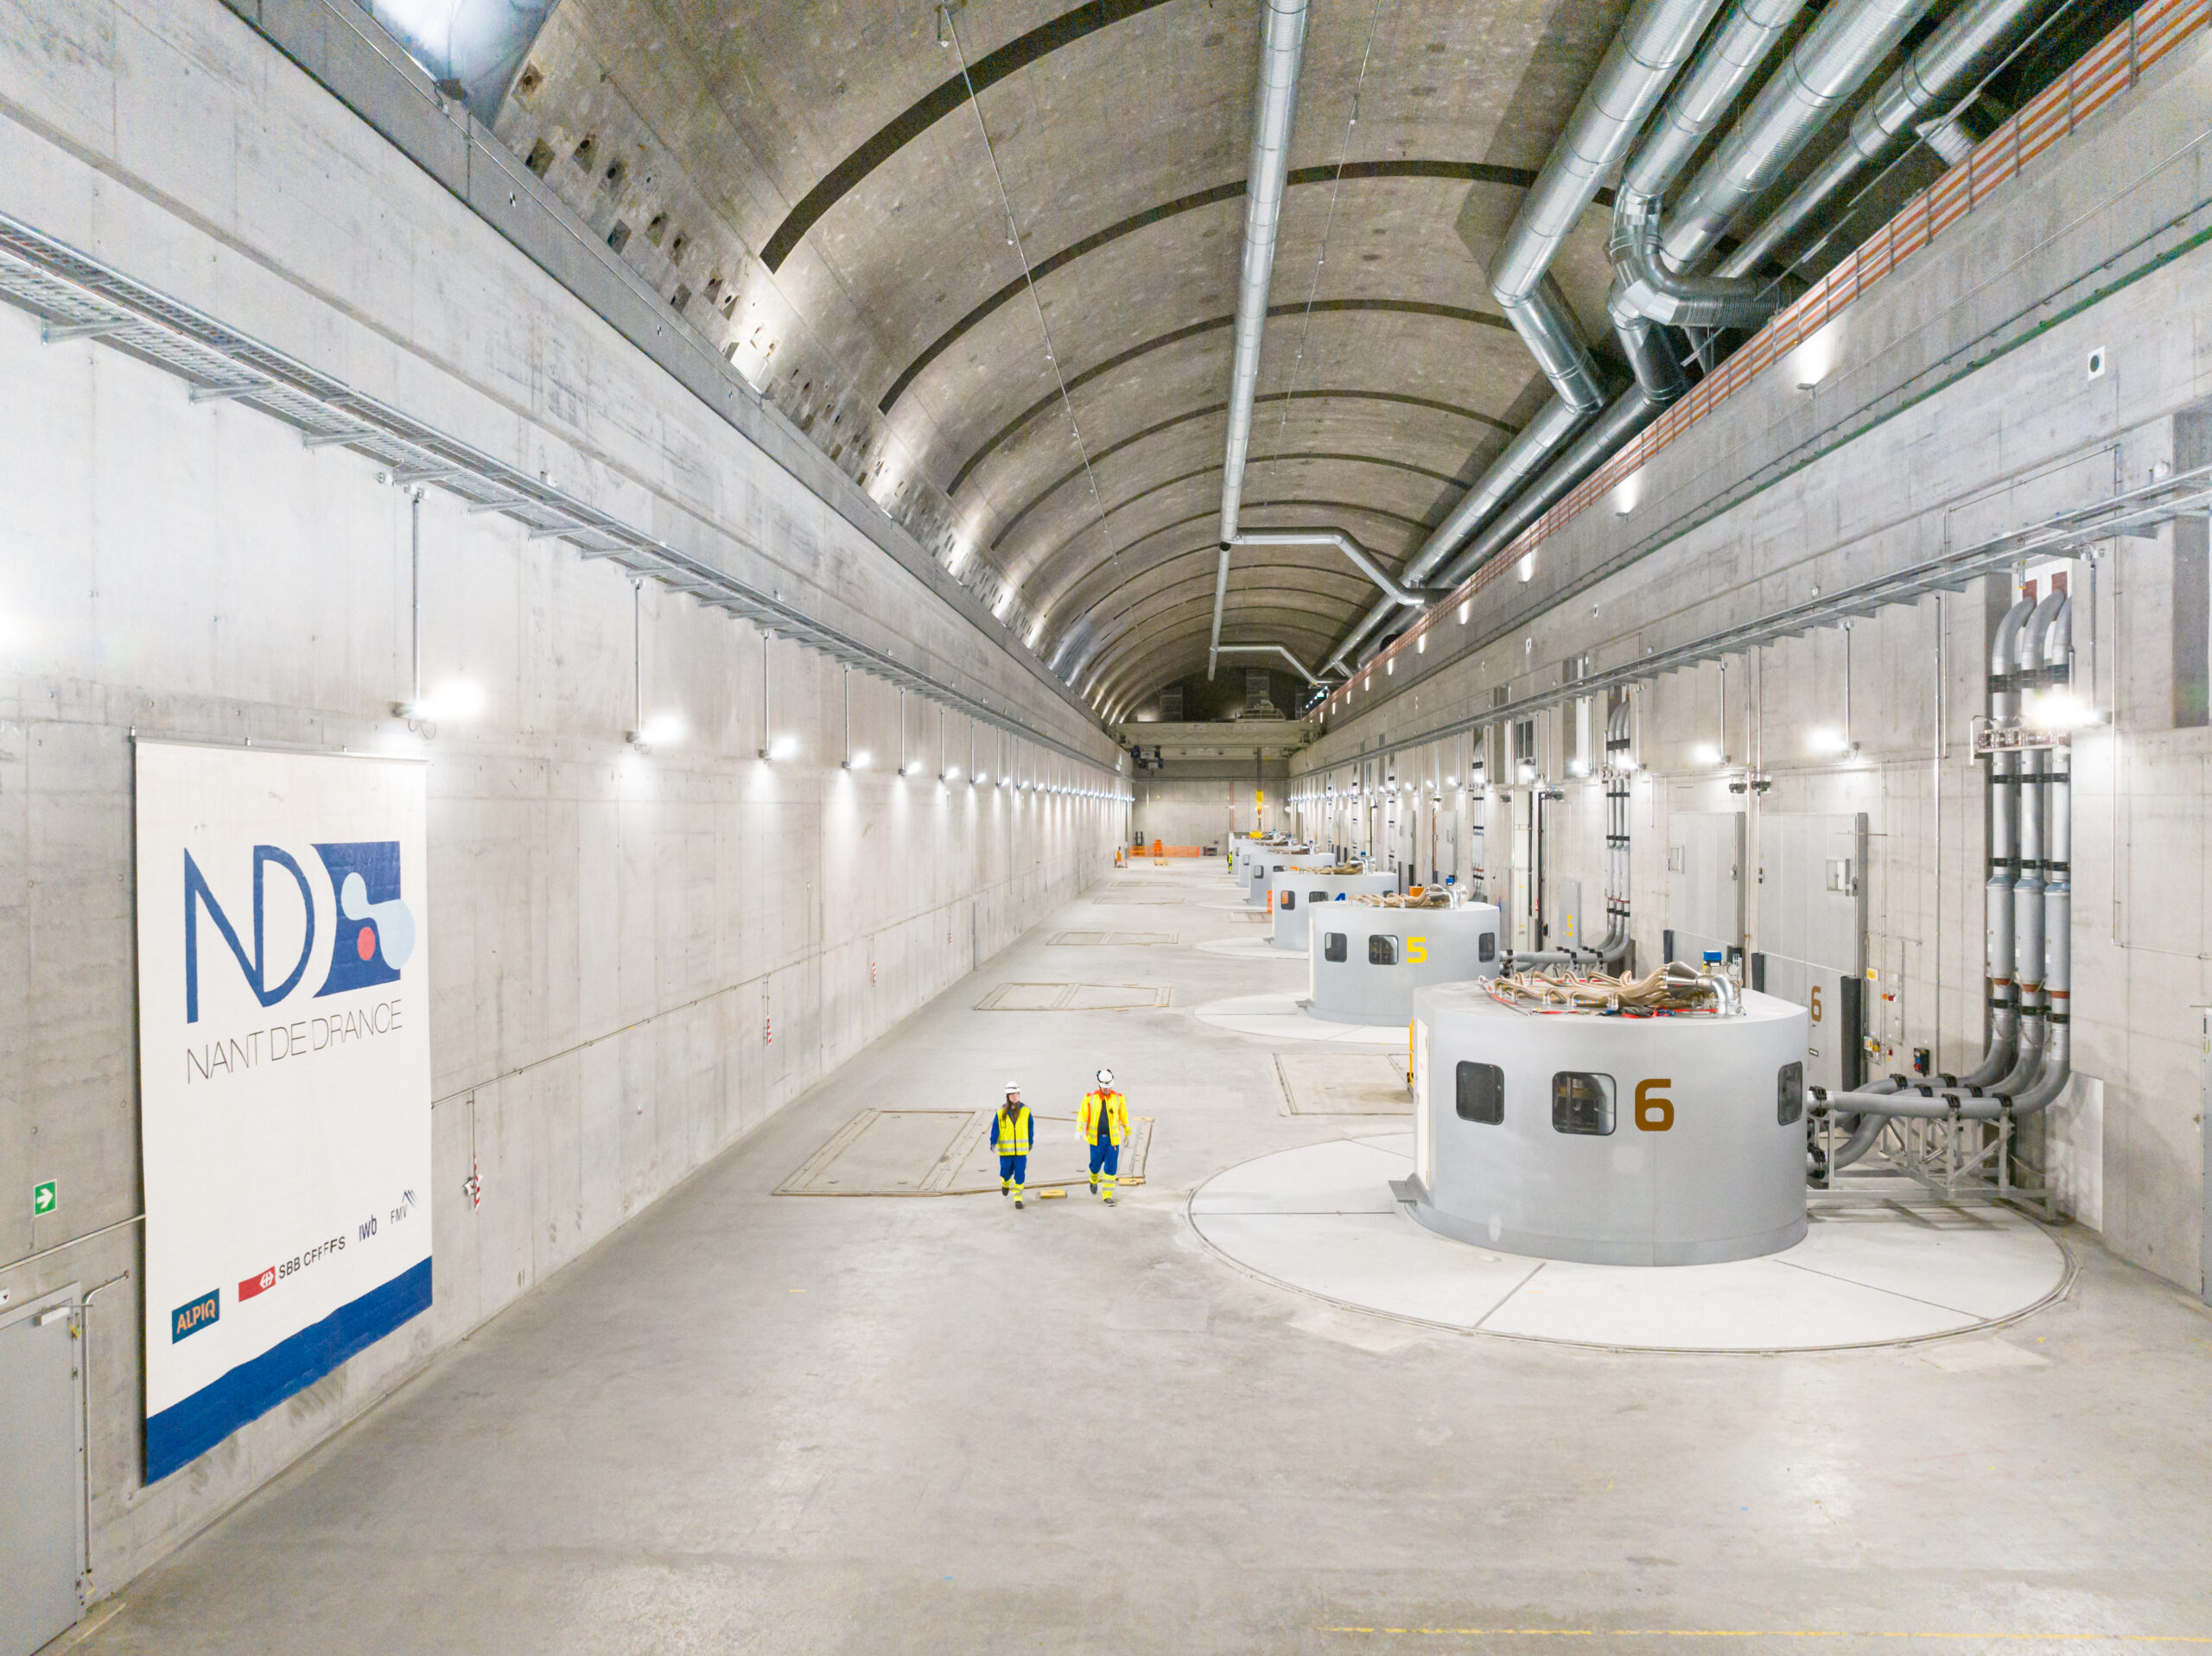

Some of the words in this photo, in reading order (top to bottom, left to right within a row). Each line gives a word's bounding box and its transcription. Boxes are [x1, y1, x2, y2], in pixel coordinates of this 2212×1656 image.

[1407, 936, 1427, 963] 5
[1810, 986, 1822, 1023] 6
[187, 1031, 264, 1084] NANT
[270, 1021, 307, 1062] DE
[311, 999, 403, 1051] DRANCE
[1635, 1078, 1675, 1132] 6
[391, 1204, 407, 1225] FMV
[278, 1256, 301, 1279] SBB
[176, 1298, 216, 1335] ALPIQ
